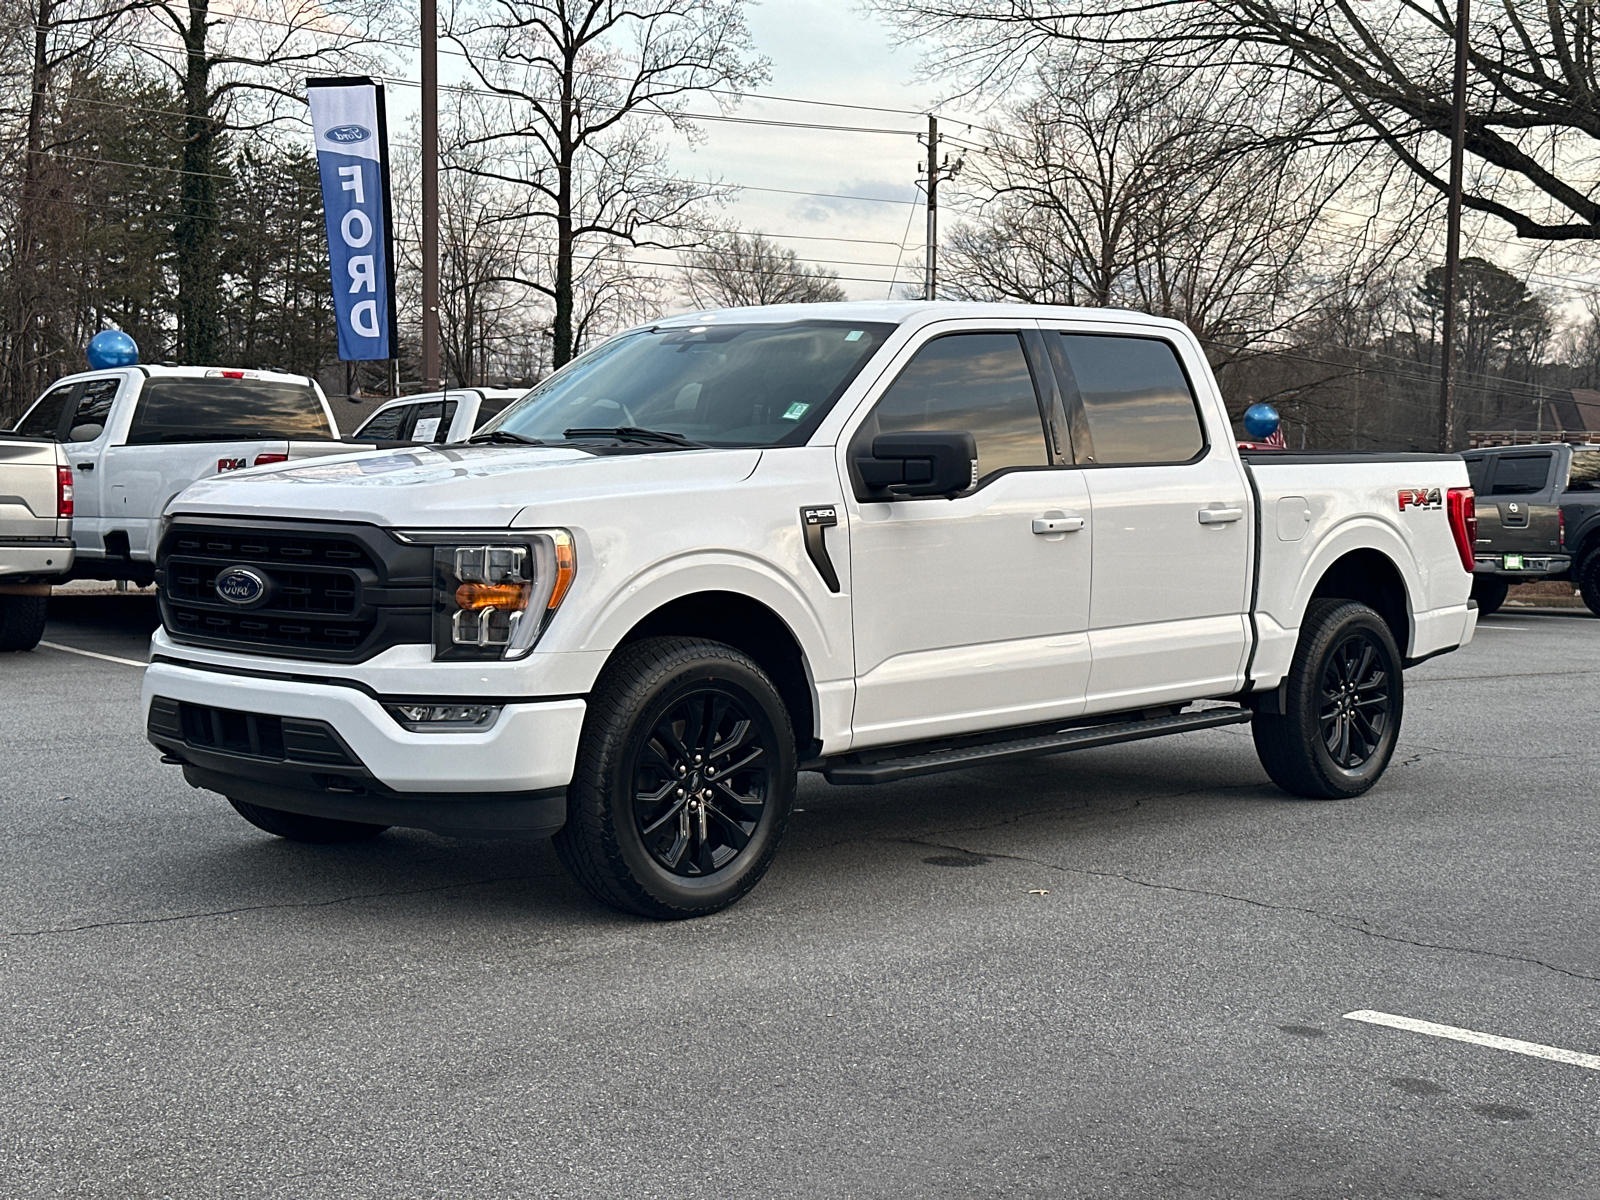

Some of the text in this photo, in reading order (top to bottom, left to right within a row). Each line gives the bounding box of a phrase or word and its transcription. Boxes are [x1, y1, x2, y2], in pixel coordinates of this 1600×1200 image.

[217, 458, 247, 473] FX4
[1397, 488, 1442, 512] FX4
[805, 509, 835, 518] F-150
[223, 576, 250, 596] Ford
